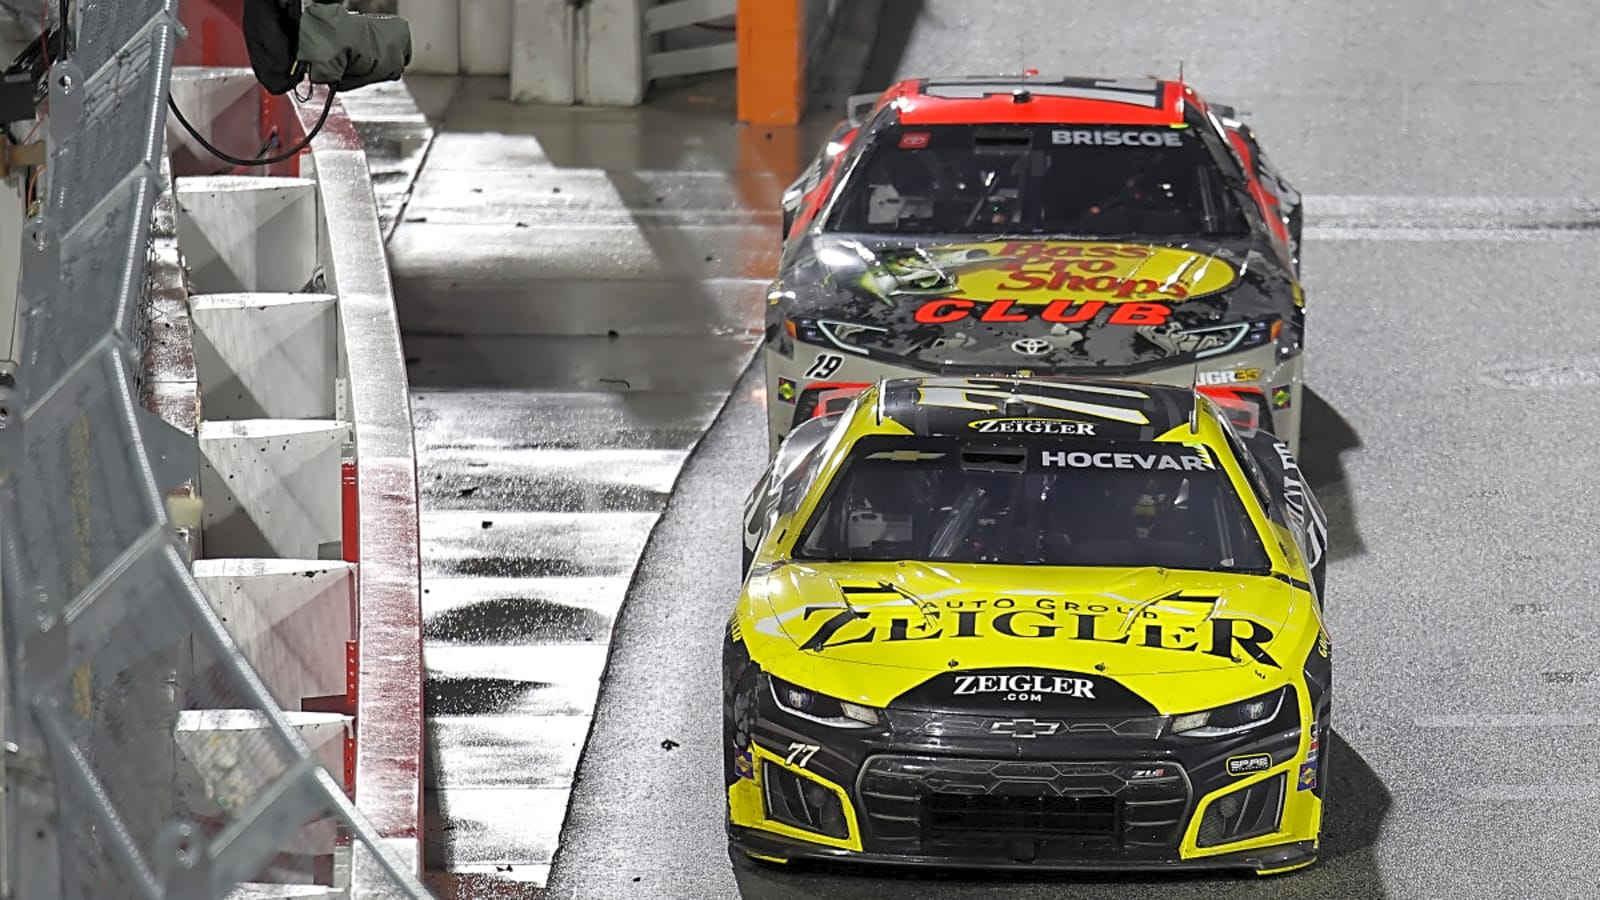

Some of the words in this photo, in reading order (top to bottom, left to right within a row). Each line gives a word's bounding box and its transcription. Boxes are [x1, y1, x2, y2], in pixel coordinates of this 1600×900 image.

[1051, 130, 1183, 147] BRISCOE
[996, 242, 1148, 258] Bass
[997, 256, 1116, 273] Pro
[997, 270, 1188, 298] Shops
[914, 300, 1172, 325] CLUB
[803, 353, 845, 380] 19
[979, 420, 1097, 436] ZEIGLER
[1042, 451, 1207, 471] HOCEVAR
[923, 599, 1015, 609] AUTO
[1036, 598, 1158, 619] GROUP
[798, 606, 1282, 670] ZEIGLER
[953, 675, 1096, 699] ZEIGLER
[1003, 693, 1042, 702] .COM
[785, 742, 820, 768] 77
